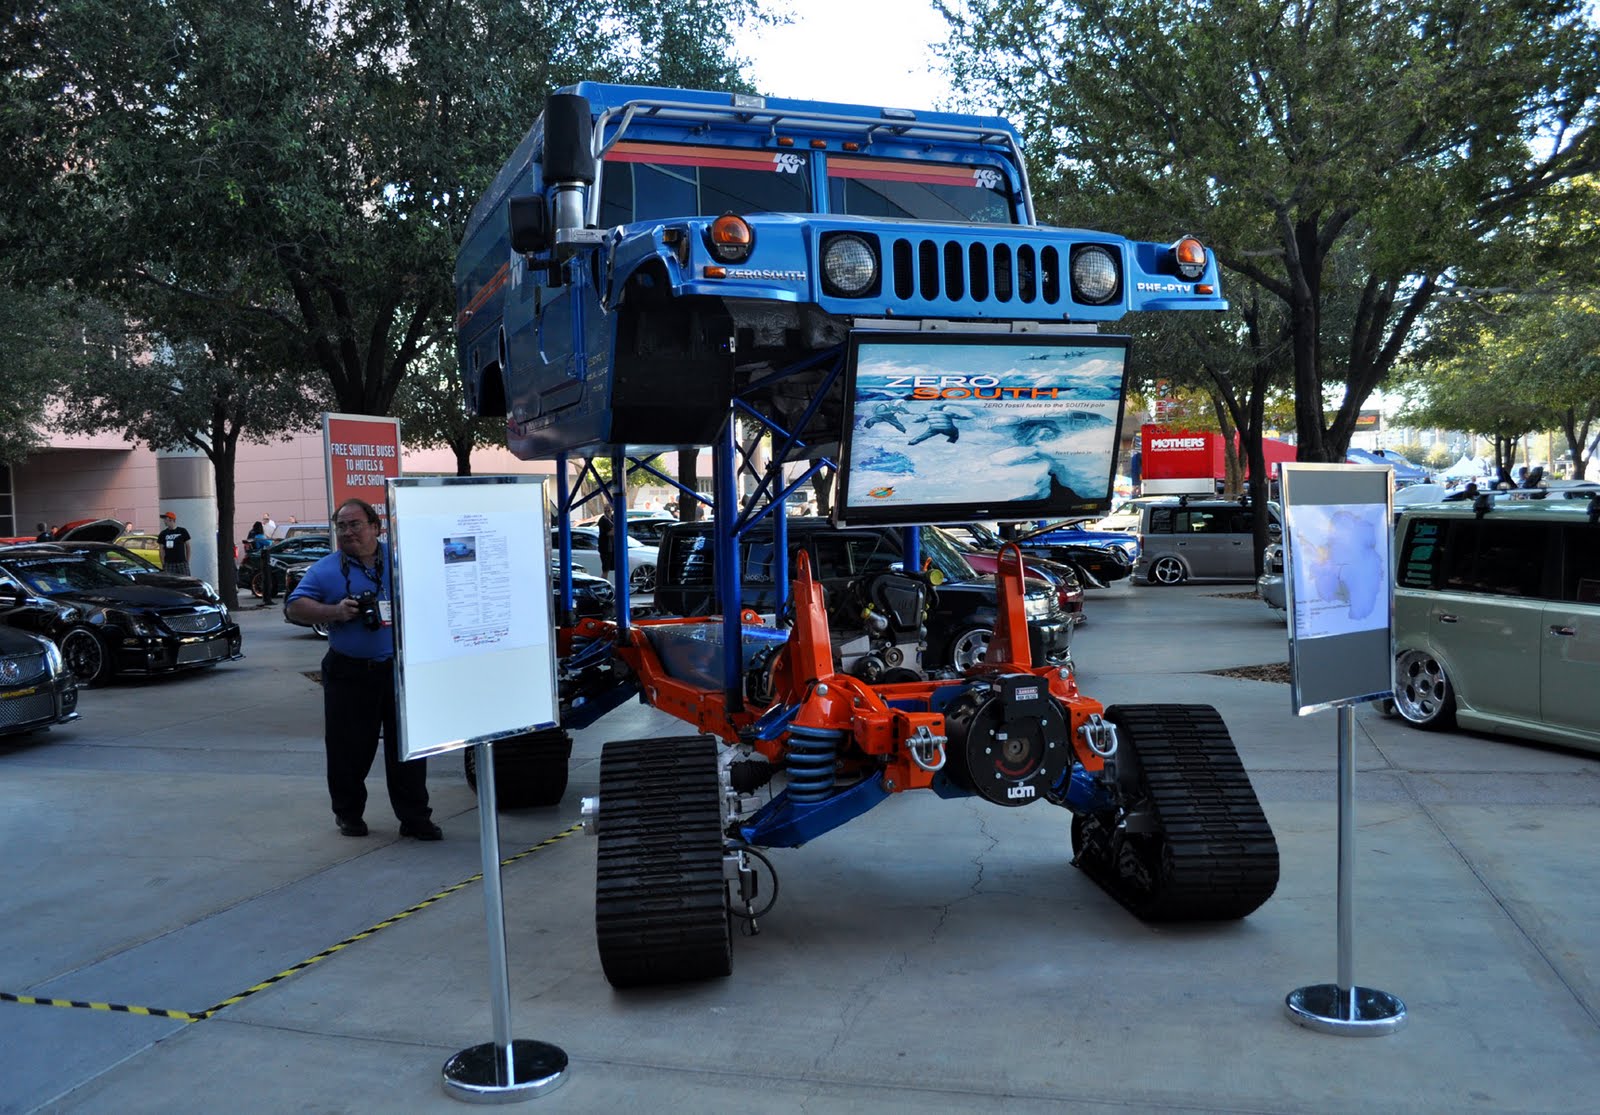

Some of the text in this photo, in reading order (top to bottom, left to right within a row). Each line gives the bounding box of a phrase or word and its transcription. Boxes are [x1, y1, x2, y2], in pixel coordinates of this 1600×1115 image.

[885, 375, 1000, 388] ZERO
[912, 387, 1058, 399] SOUTH
[1151, 438, 1205, 448] MOTHERS
[331, 443, 395, 457] FREE SHUTTLE BUSES
[345, 459, 384, 472] TO HOTELS &
[346, 474, 385, 486] AAPEX SHOW
